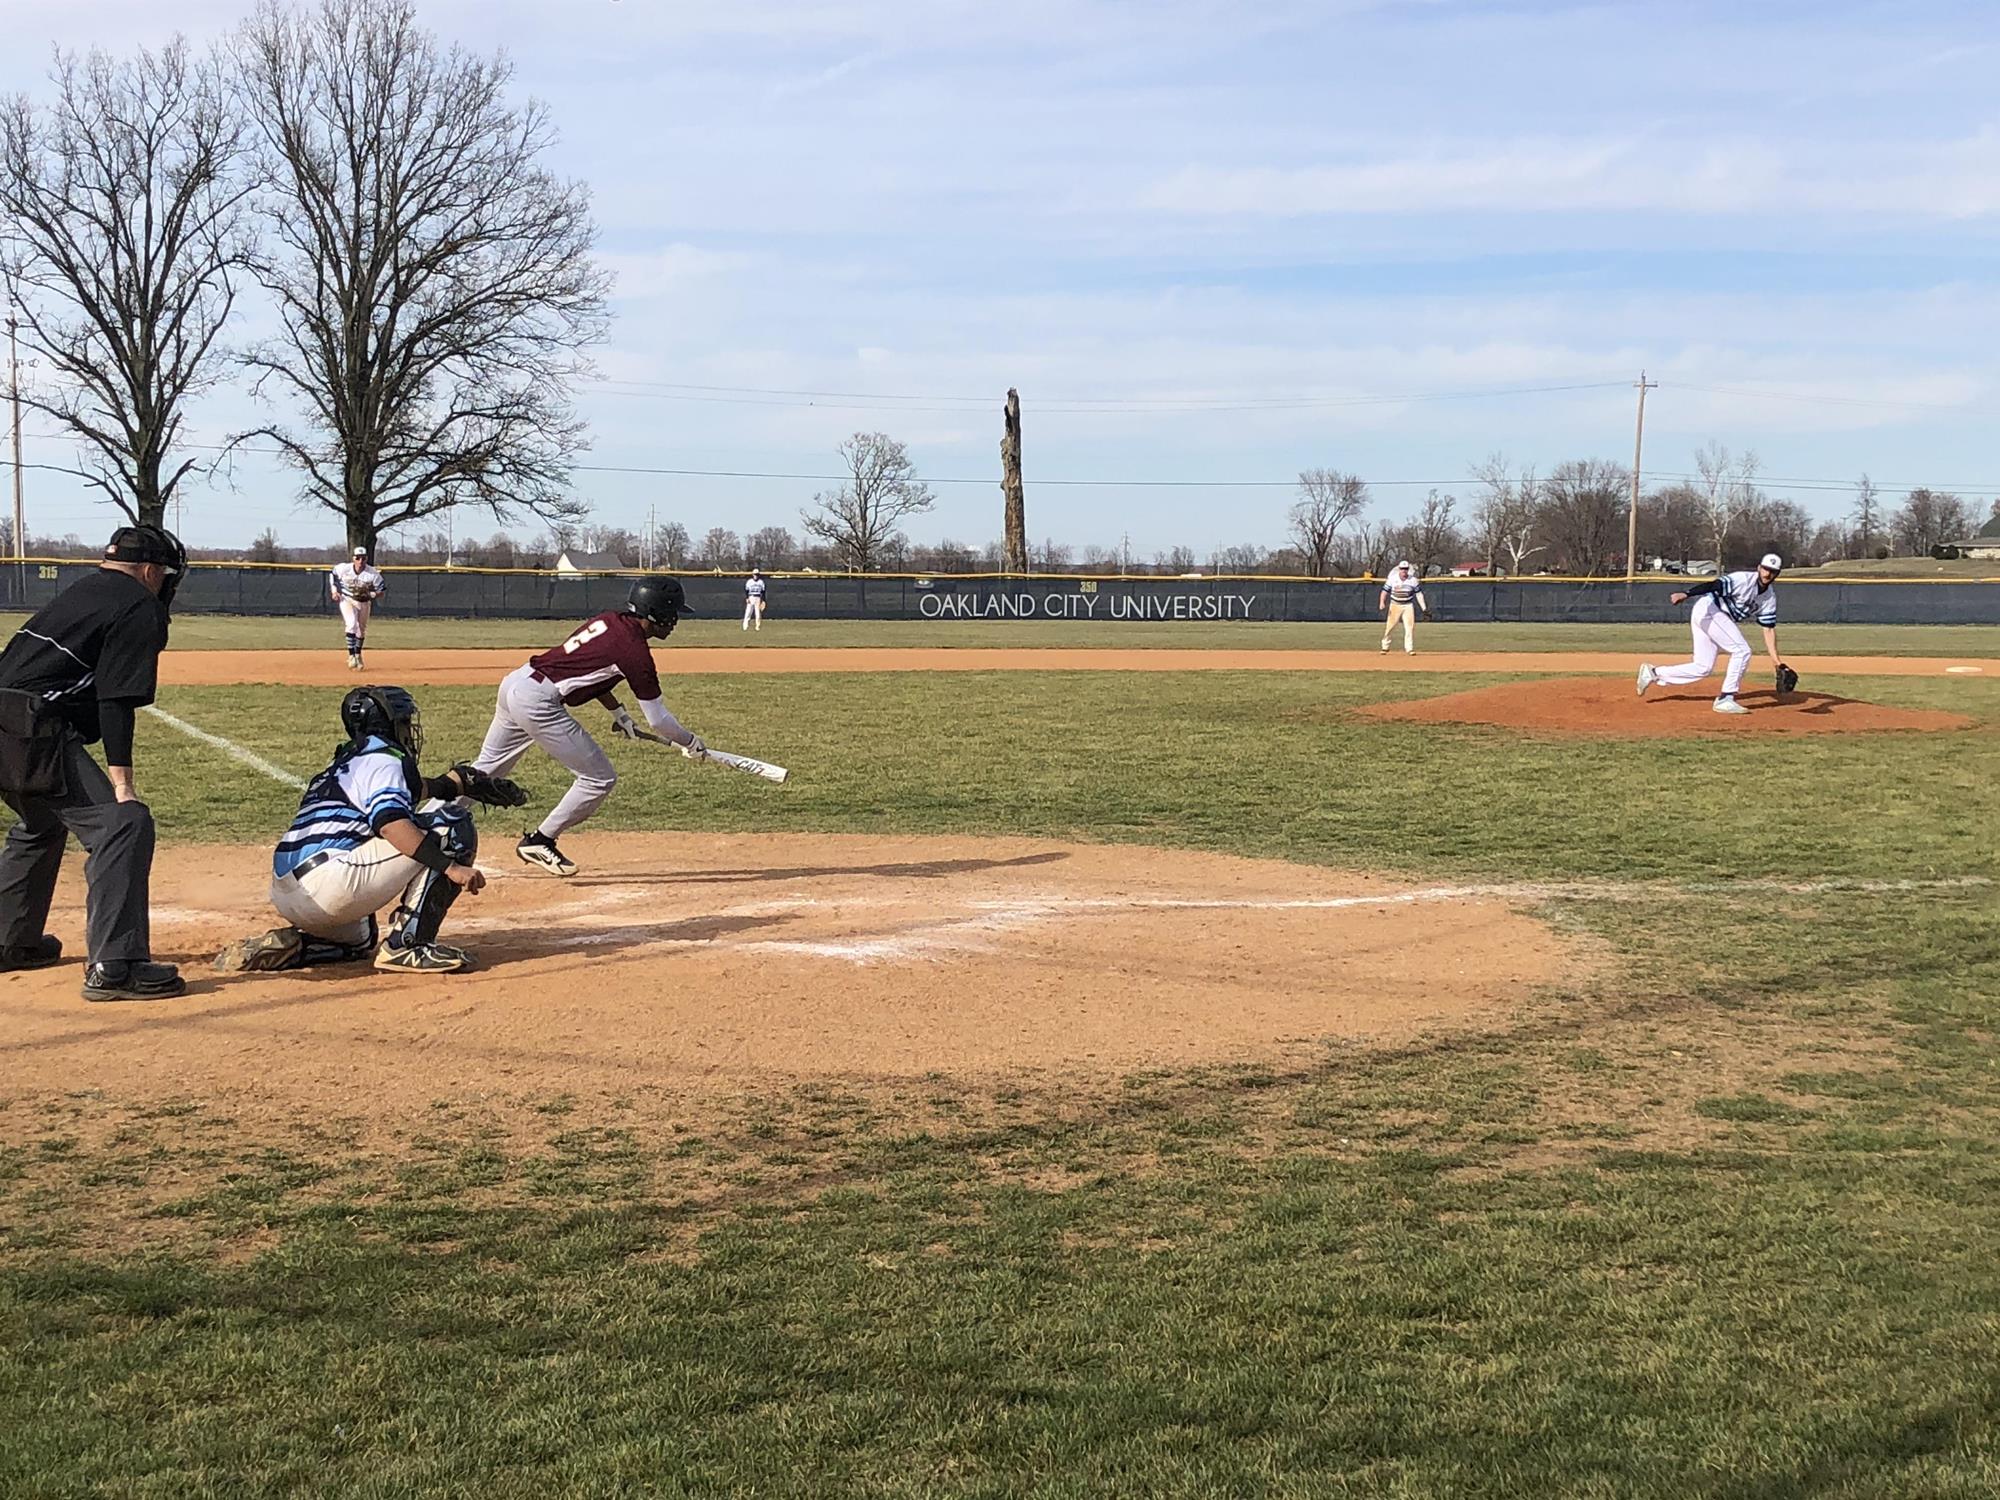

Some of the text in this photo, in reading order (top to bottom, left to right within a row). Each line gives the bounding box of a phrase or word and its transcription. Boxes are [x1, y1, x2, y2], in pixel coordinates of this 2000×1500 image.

[38, 565, 58, 579] 315
[1080, 581, 1097, 593] 350
[919, 593, 1257, 619] OAKLAND CITY UNIVERSITY
[563, 619, 608, 654] 2
